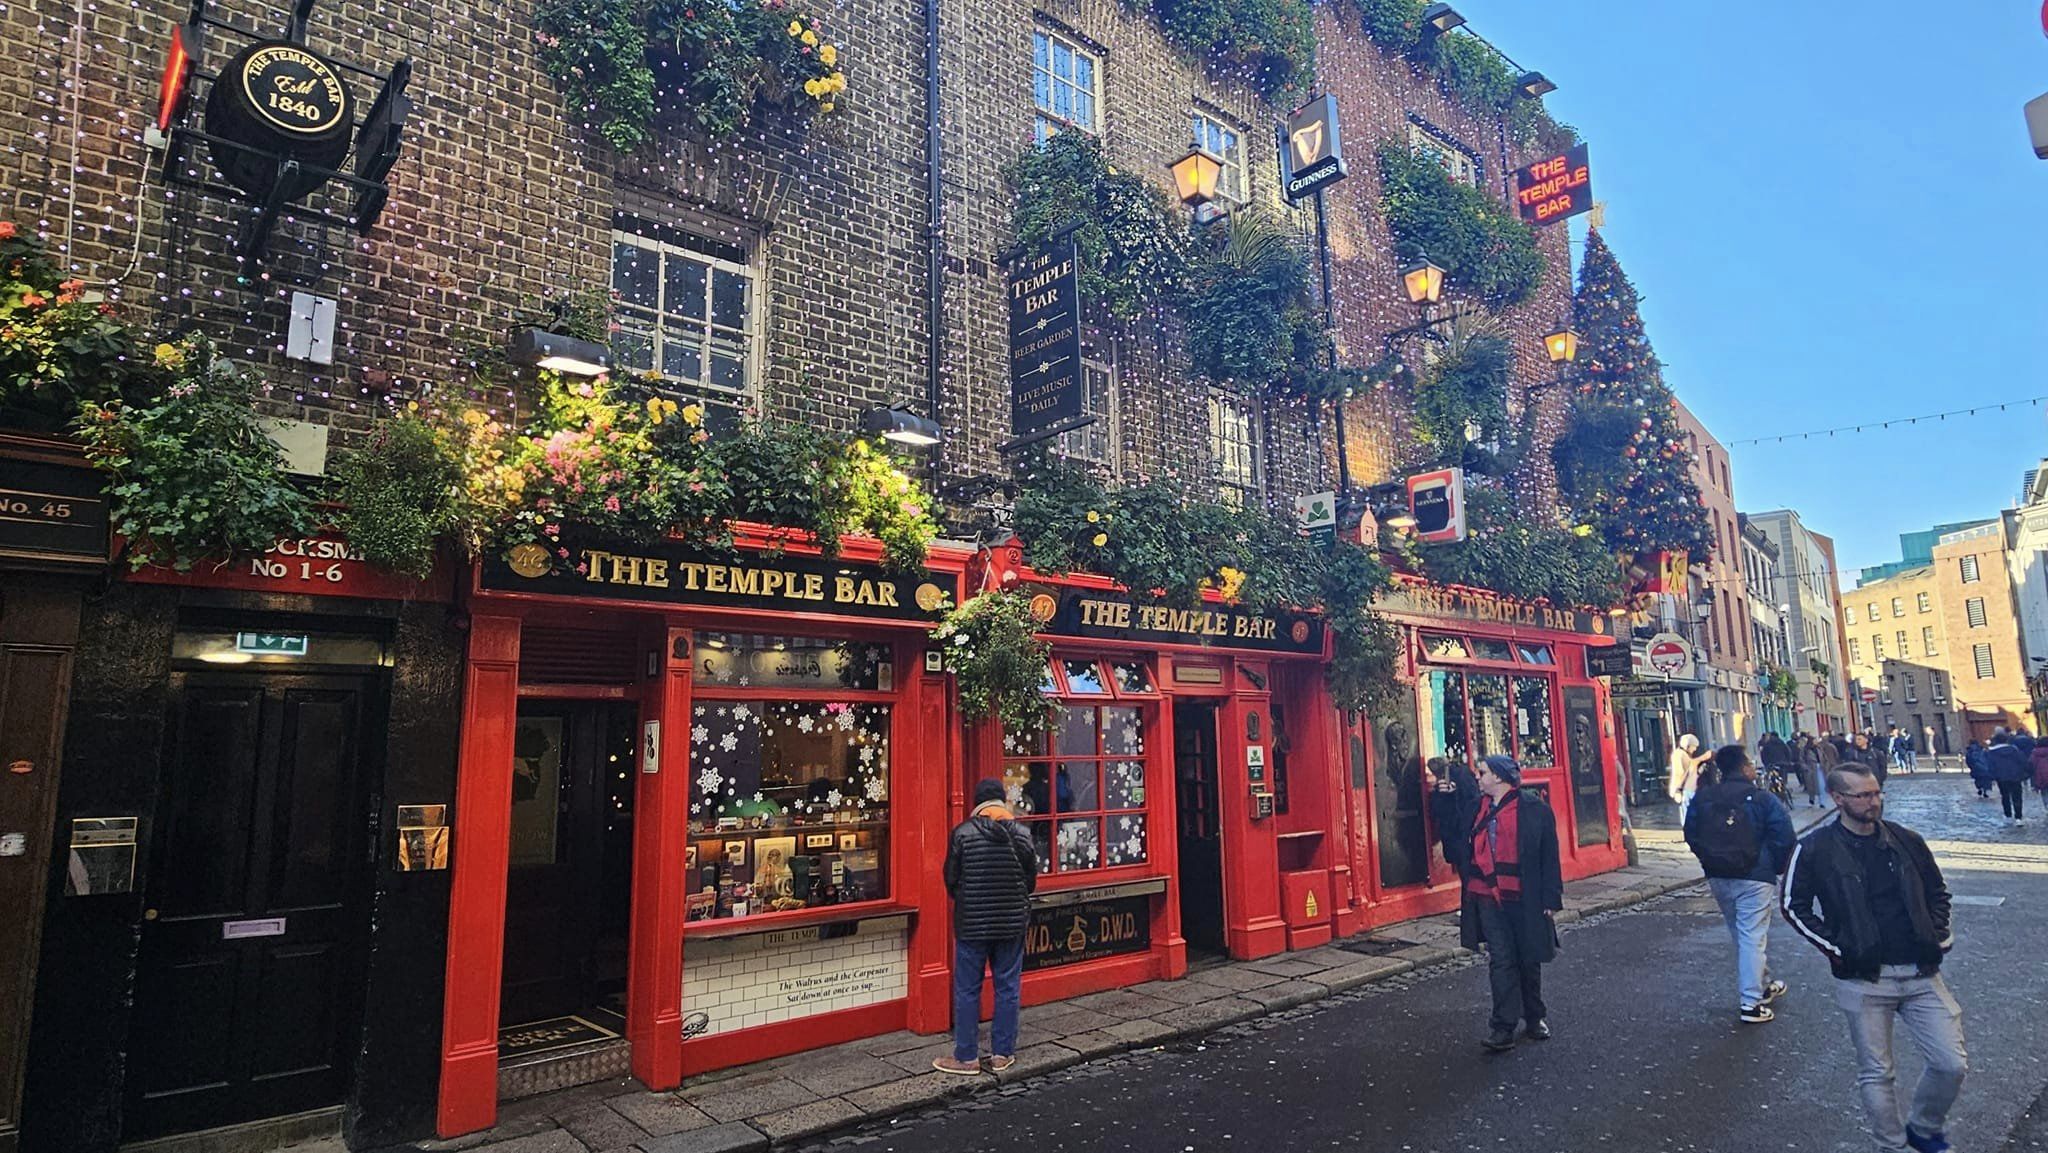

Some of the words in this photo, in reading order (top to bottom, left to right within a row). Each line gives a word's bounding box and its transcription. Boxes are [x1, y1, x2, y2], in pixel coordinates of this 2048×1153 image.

[248, 54, 271, 76] THE
[269, 51, 326, 76] TEMPLE
[323, 77, 340, 103] BAR
[268, 92, 320, 121] 1840
[1290, 163, 1337, 192] GUINNESS
[1531, 155, 1566, 181] THE
[1519, 166, 1588, 205] TEMPLE
[1536, 194, 1571, 219] BAR
[1031, 253, 1051, 270] THE
[1012, 259, 1073, 299] TEMPLE
[1025, 288, 1058, 315] BAR
[1014, 341, 1036, 359] BEER
[1037, 327, 1073, 349] GARDEN
[1018, 387, 1040, 404] LIVE
[1041, 375, 1073, 395] MUSIC
[1030, 395, 1059, 413] DAILY
[40, 502, 71, 518] 45
[250, 558, 288, 578] No
[300, 562, 343, 582] 1-6
[581, 549, 669, 588] THE
[680, 562, 824, 600] TEMPLE
[834, 577, 899, 607] BAR
[1079, 599, 1131, 629] THE
[1138, 605, 1228, 635] TEMPLE
[1233, 614, 1276, 640] BAR
[1410, 587, 1456, 615] THE
[1461, 597, 1536, 626] TEMPLE
[1543, 607, 1576, 631] BAR
[1101, 912, 1138, 942] D.W.D.
[779, 981, 793, 991] The
[795, 977, 822, 989] Walrus
[824, 973, 838, 984] and
[840, 970, 851, 981] the
[853, 966, 889, 980] Carpenter
[787, 993, 799, 1003] Sat
[801, 989, 821, 1001] down
[823, 987, 831, 997] at
[833, 986, 849, 996] once
[851, 983, 860, 992] to
